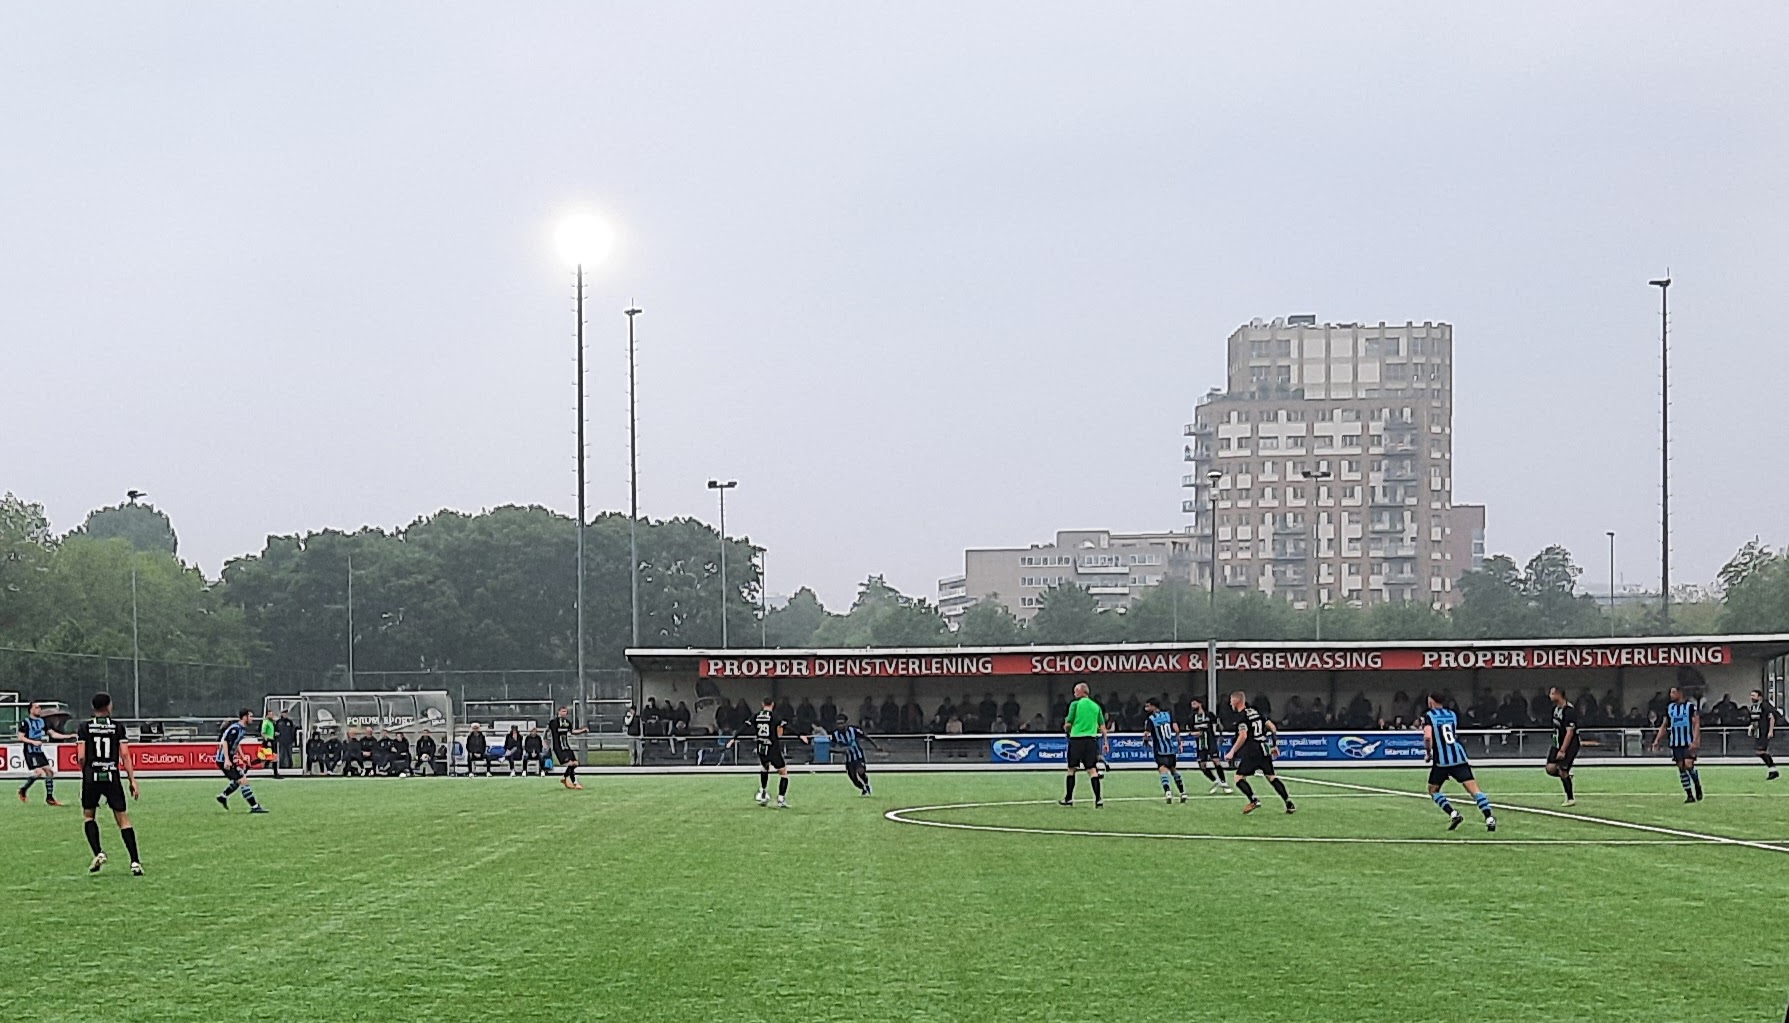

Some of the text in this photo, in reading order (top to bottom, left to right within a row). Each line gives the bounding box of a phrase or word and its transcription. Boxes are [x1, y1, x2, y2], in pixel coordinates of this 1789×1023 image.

[708, 657, 993, 676] PROPER DIENSTVERLENING
[1031, 652, 1382, 673] SCHOONMAAK & GLASBEWASSING
[1422, 647, 1722, 668] PROPER DIENSTVERLENING
[1160, 722, 1172, 740] 10
[1442, 723, 1456, 745] 6
[93, 736, 111, 759] 11
[141, 753, 185, 764] Solutions
